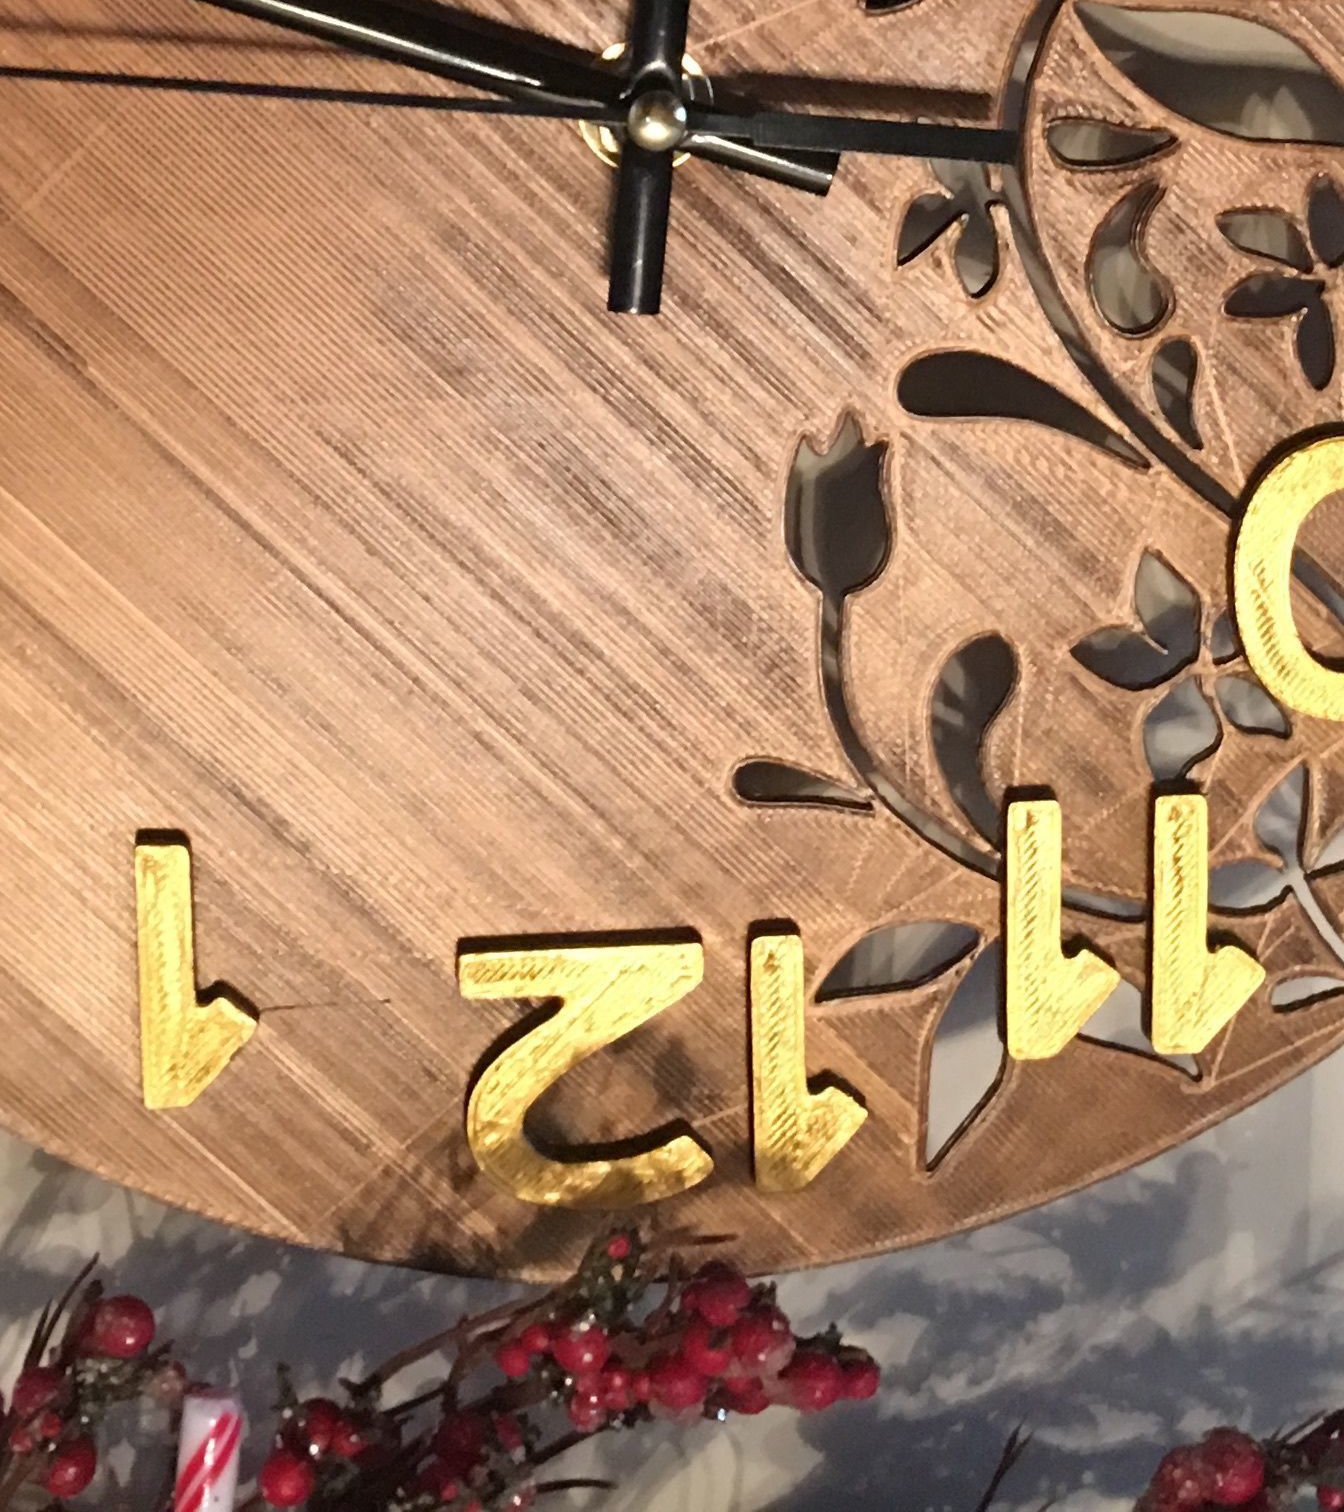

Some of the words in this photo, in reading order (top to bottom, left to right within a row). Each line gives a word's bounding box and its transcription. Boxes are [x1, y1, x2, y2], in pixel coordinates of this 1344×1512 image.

[134, 844, 259, 1109] 1
[1002, 797, 1266, 1062] 11
[460, 934, 867, 1203] 12
